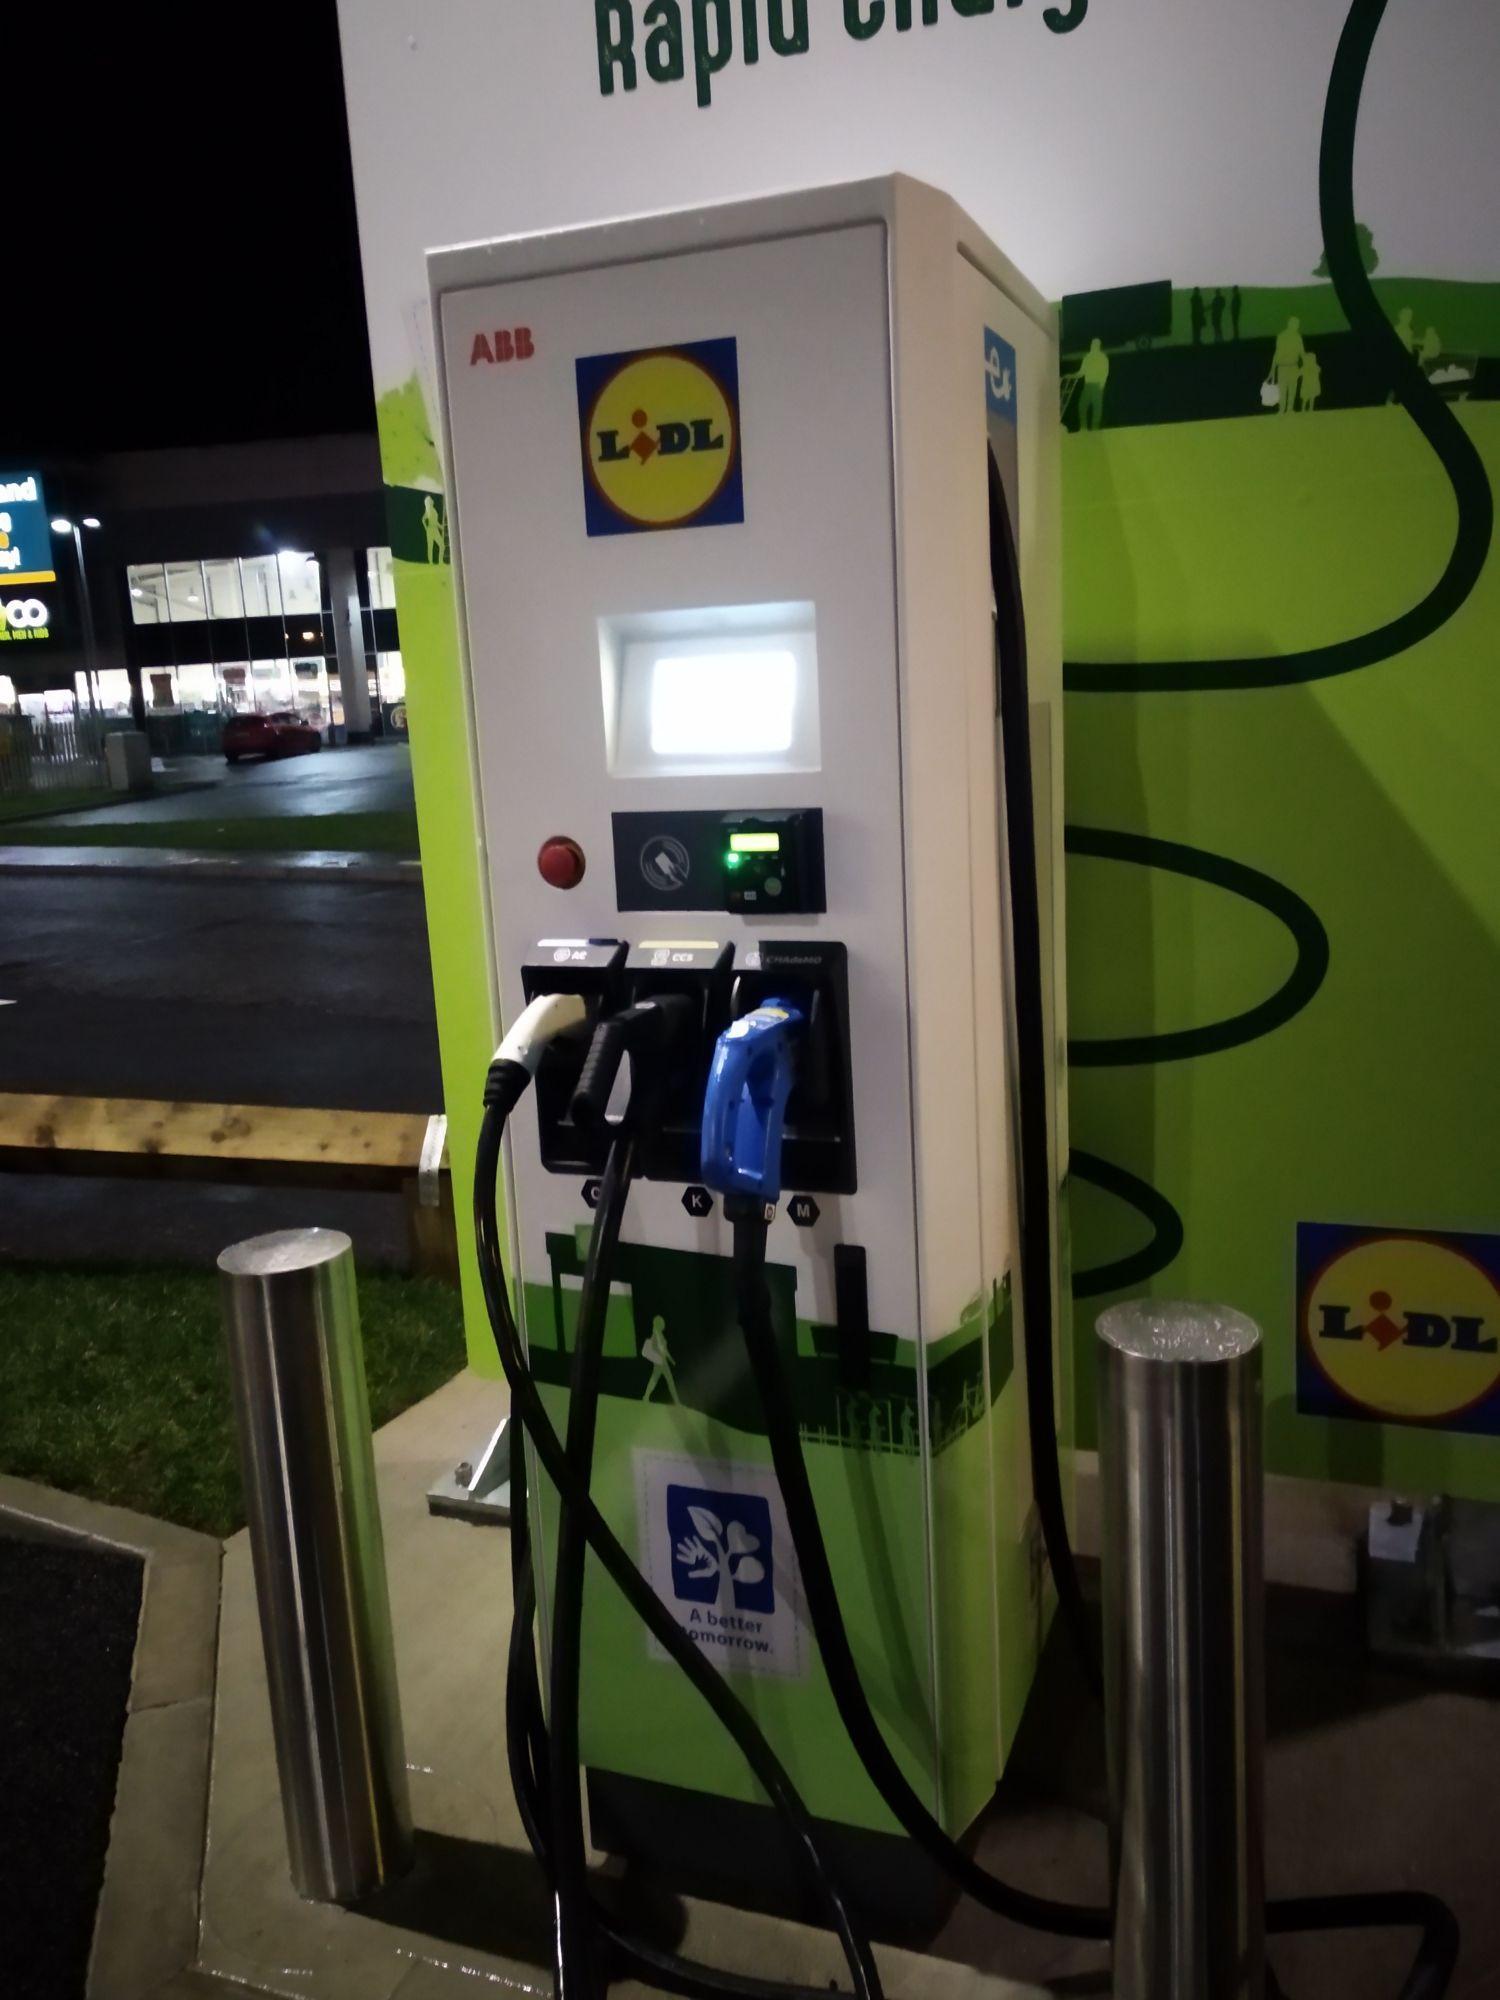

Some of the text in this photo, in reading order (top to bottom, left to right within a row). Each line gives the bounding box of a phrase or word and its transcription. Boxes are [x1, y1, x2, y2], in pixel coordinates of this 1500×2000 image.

[470, 327, 535, 366] ABB
[691, 1194, 703, 1209] K
[796, 1203, 810, 1218] M
[690, 1608, 763, 1633] A better
